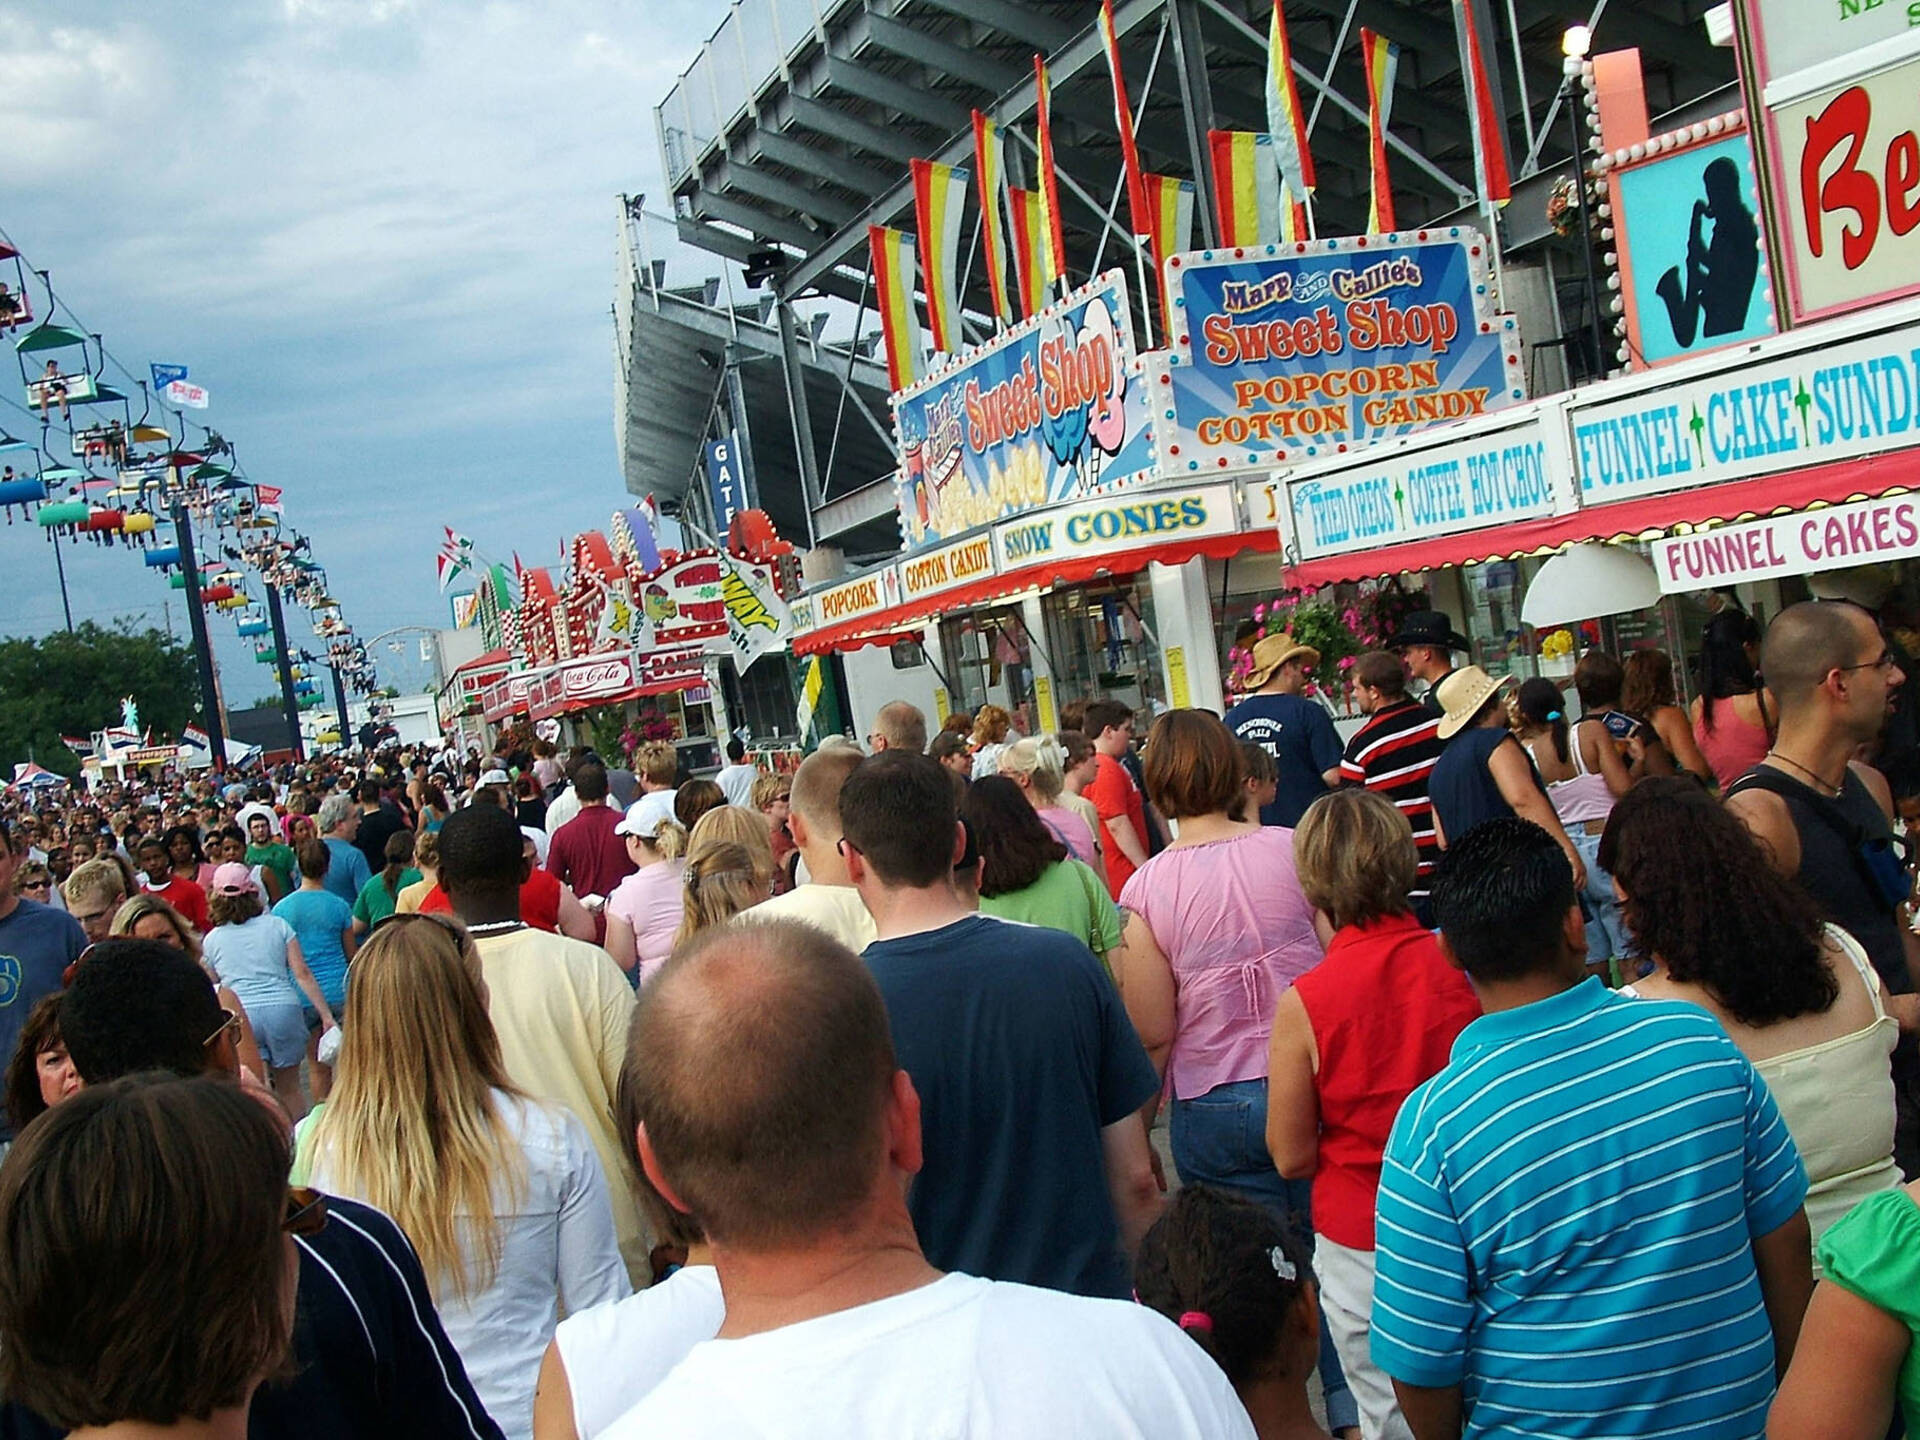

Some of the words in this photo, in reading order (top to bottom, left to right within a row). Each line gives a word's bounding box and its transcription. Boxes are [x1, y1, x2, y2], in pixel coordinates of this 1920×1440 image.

[1223, 272, 1292, 313] Mary
[1329, 255, 1422, 299] Callie's
[1203, 309, 1342, 366] Sweet
[1346, 298, 1458, 355] Shop
[964, 351, 1043, 454] Sweet
[1039, 332, 1118, 420] Shop
[1233, 358, 1439, 409] POPCORN
[1198, 404, 1348, 446] COTTON
[1364, 387, 1489, 428] CANDY
[1576, 405, 1692, 491] FUNNEL
[1708, 377, 1798, 464] CAKE
[714, 444, 736, 524] GATE
[1408, 459, 1466, 526] COFFEE
[1467, 451, 1503, 515] HOT
[1003, 522, 1054, 560] SNOW
[1066, 496, 1207, 544] CONES
[1665, 526, 1787, 582] FUNNEL
[1800, 503, 1920, 561] CAKES
[821, 577, 880, 621] POPCORN
[905, 547, 949, 594] COTTON
[949, 540, 991, 578] CANDY
[129, 748, 176, 760] beverages
